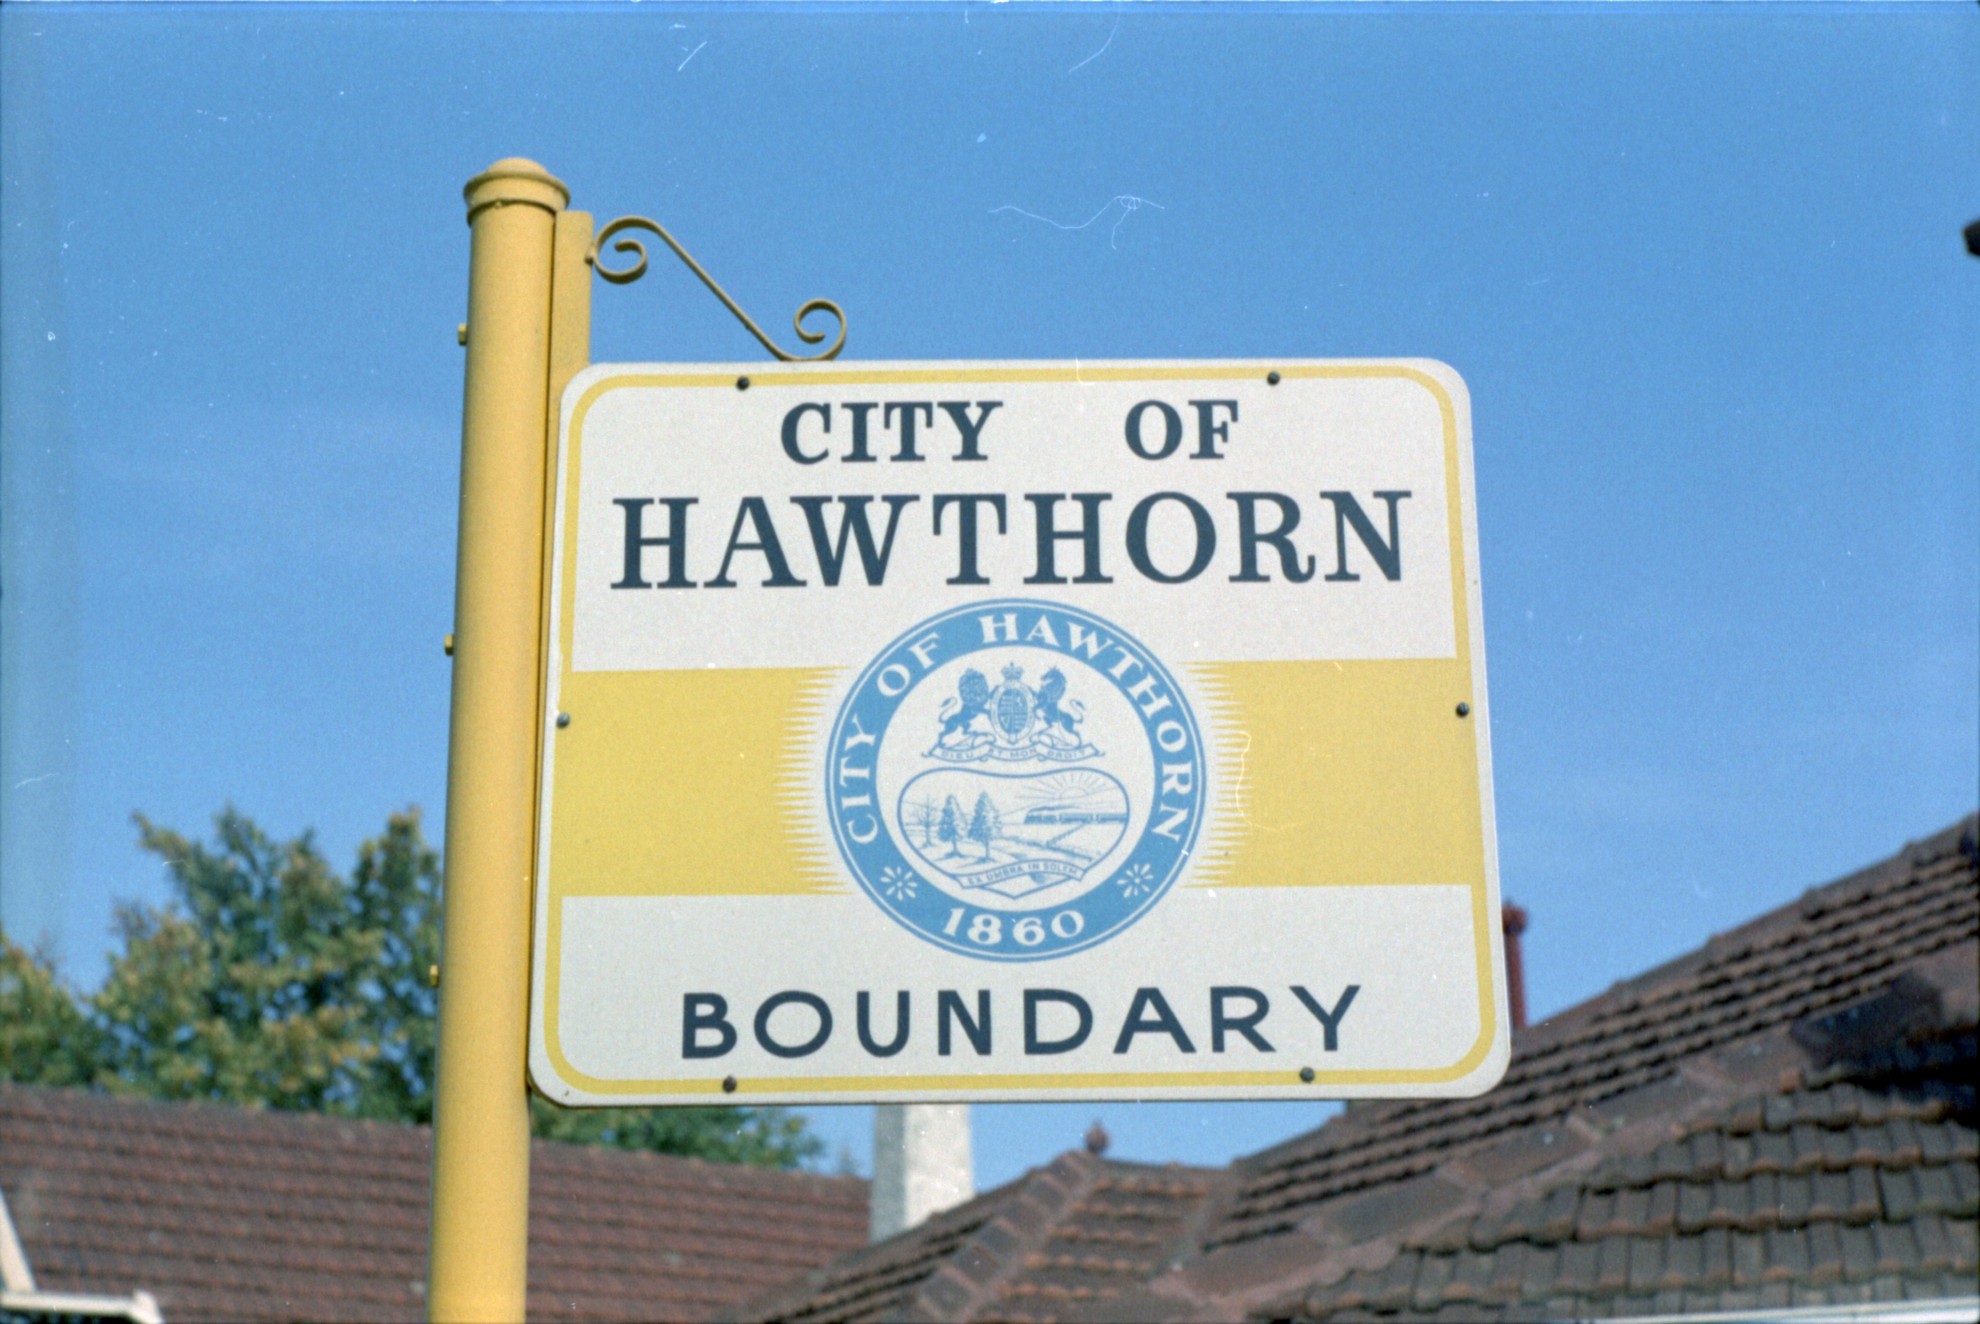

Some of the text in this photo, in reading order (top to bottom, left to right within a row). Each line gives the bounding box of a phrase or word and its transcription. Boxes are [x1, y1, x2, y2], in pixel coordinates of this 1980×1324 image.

[780, 399, 1239, 465] CITY OF
[610, 490, 1411, 589] HAWTHORN
[840, 613, 1193, 844] CITY OF HAWTHORN
[1043, 862, 1079, 876] SOLEM
[942, 907, 1084, 946] 1860
[682, 985, 1360, 1059] BOUNDARY
